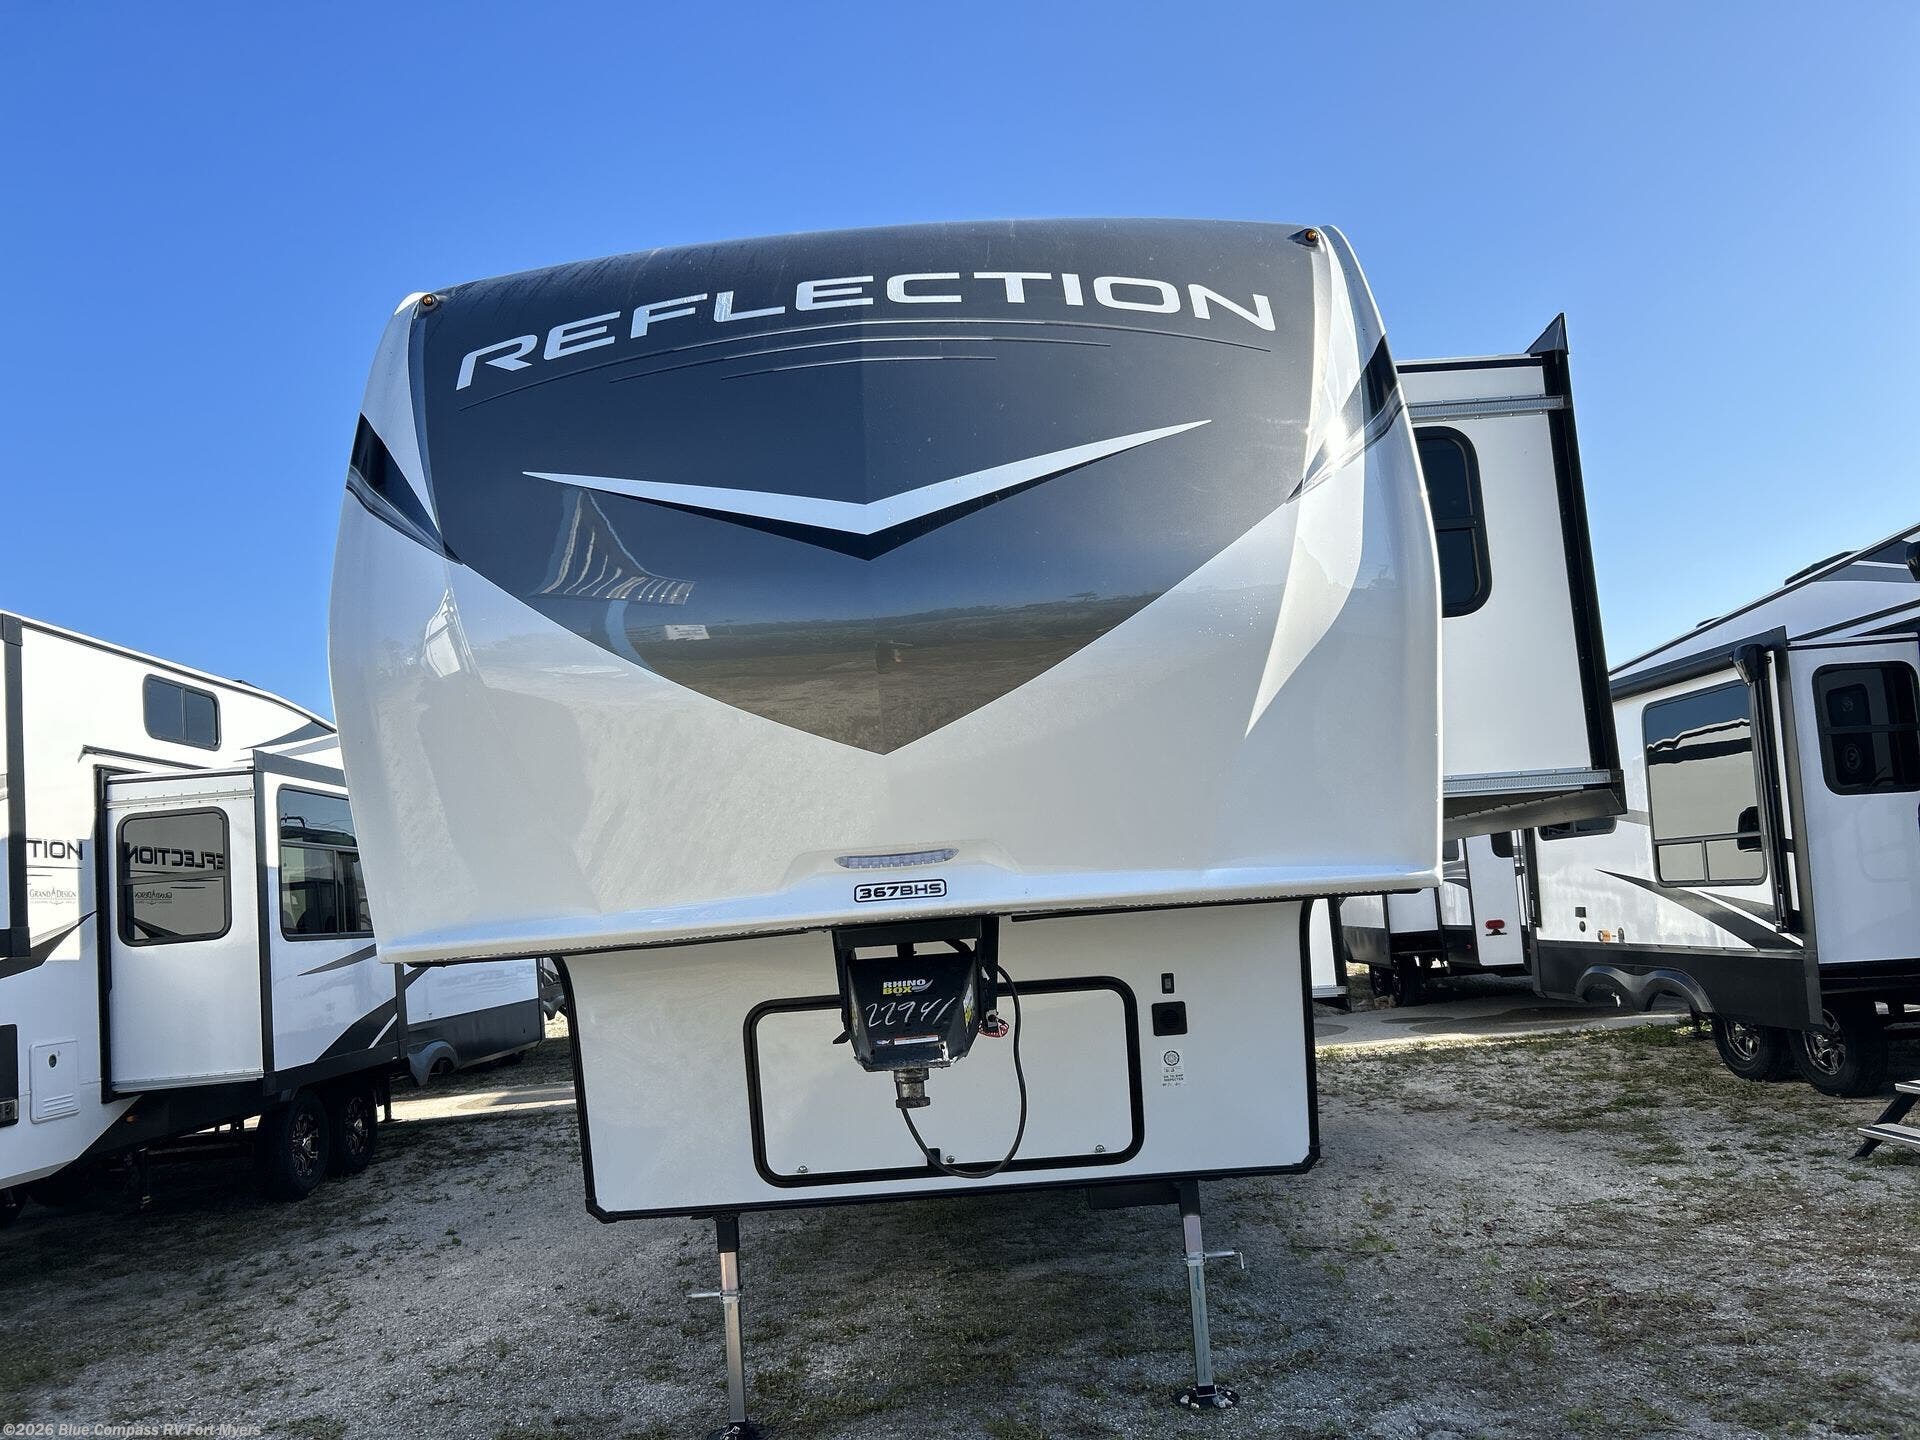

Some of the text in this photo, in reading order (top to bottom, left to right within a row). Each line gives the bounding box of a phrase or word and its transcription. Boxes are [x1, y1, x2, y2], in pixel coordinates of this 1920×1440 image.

[456, 271, 1276, 391] REFLECTION
[859, 883, 943, 900] 367BHS
[882, 978, 927, 989] RHINO
[882, 985, 913, 996] BOX
[865, 997, 957, 1028] 22941
